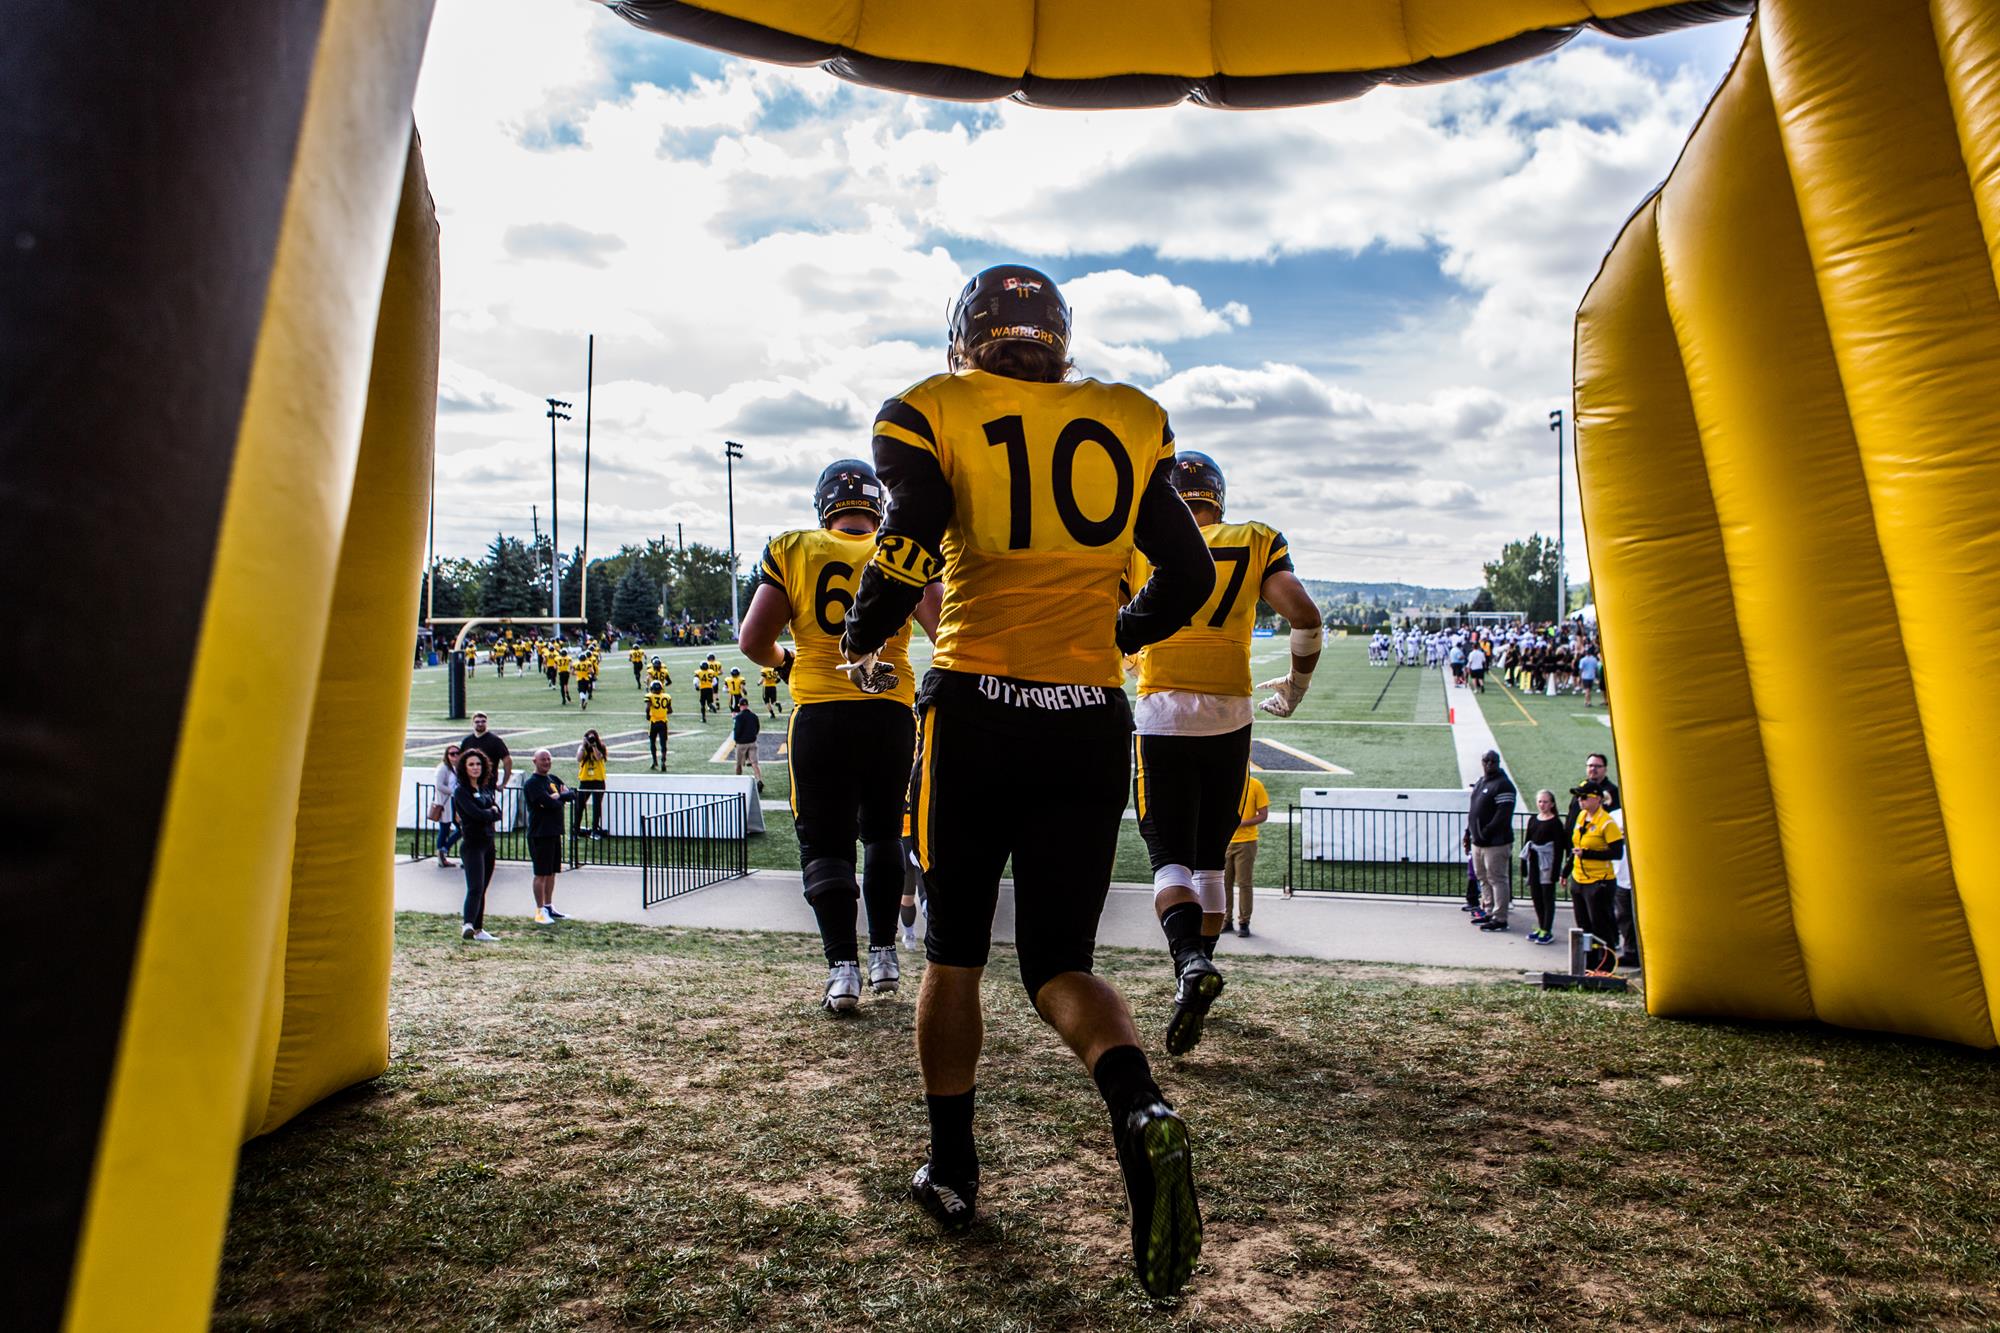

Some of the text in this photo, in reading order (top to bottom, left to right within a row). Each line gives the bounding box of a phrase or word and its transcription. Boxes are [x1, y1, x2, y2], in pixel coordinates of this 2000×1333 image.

[1016, 287, 1030, 298] 11
[991, 325, 1053, 344] WARRIORS
[982, 415, 1134, 550] 10
[835, 500, 870, 508] WARRIORS
[1184, 547, 1250, 627] 7
[815, 561, 857, 636] 6
[653, 671, 665, 681] 46
[702, 673, 713, 682] 45
[731, 681, 736, 691] 1
[654, 697, 669, 709] 30
[931, 1183, 967, 1213] NIKE
